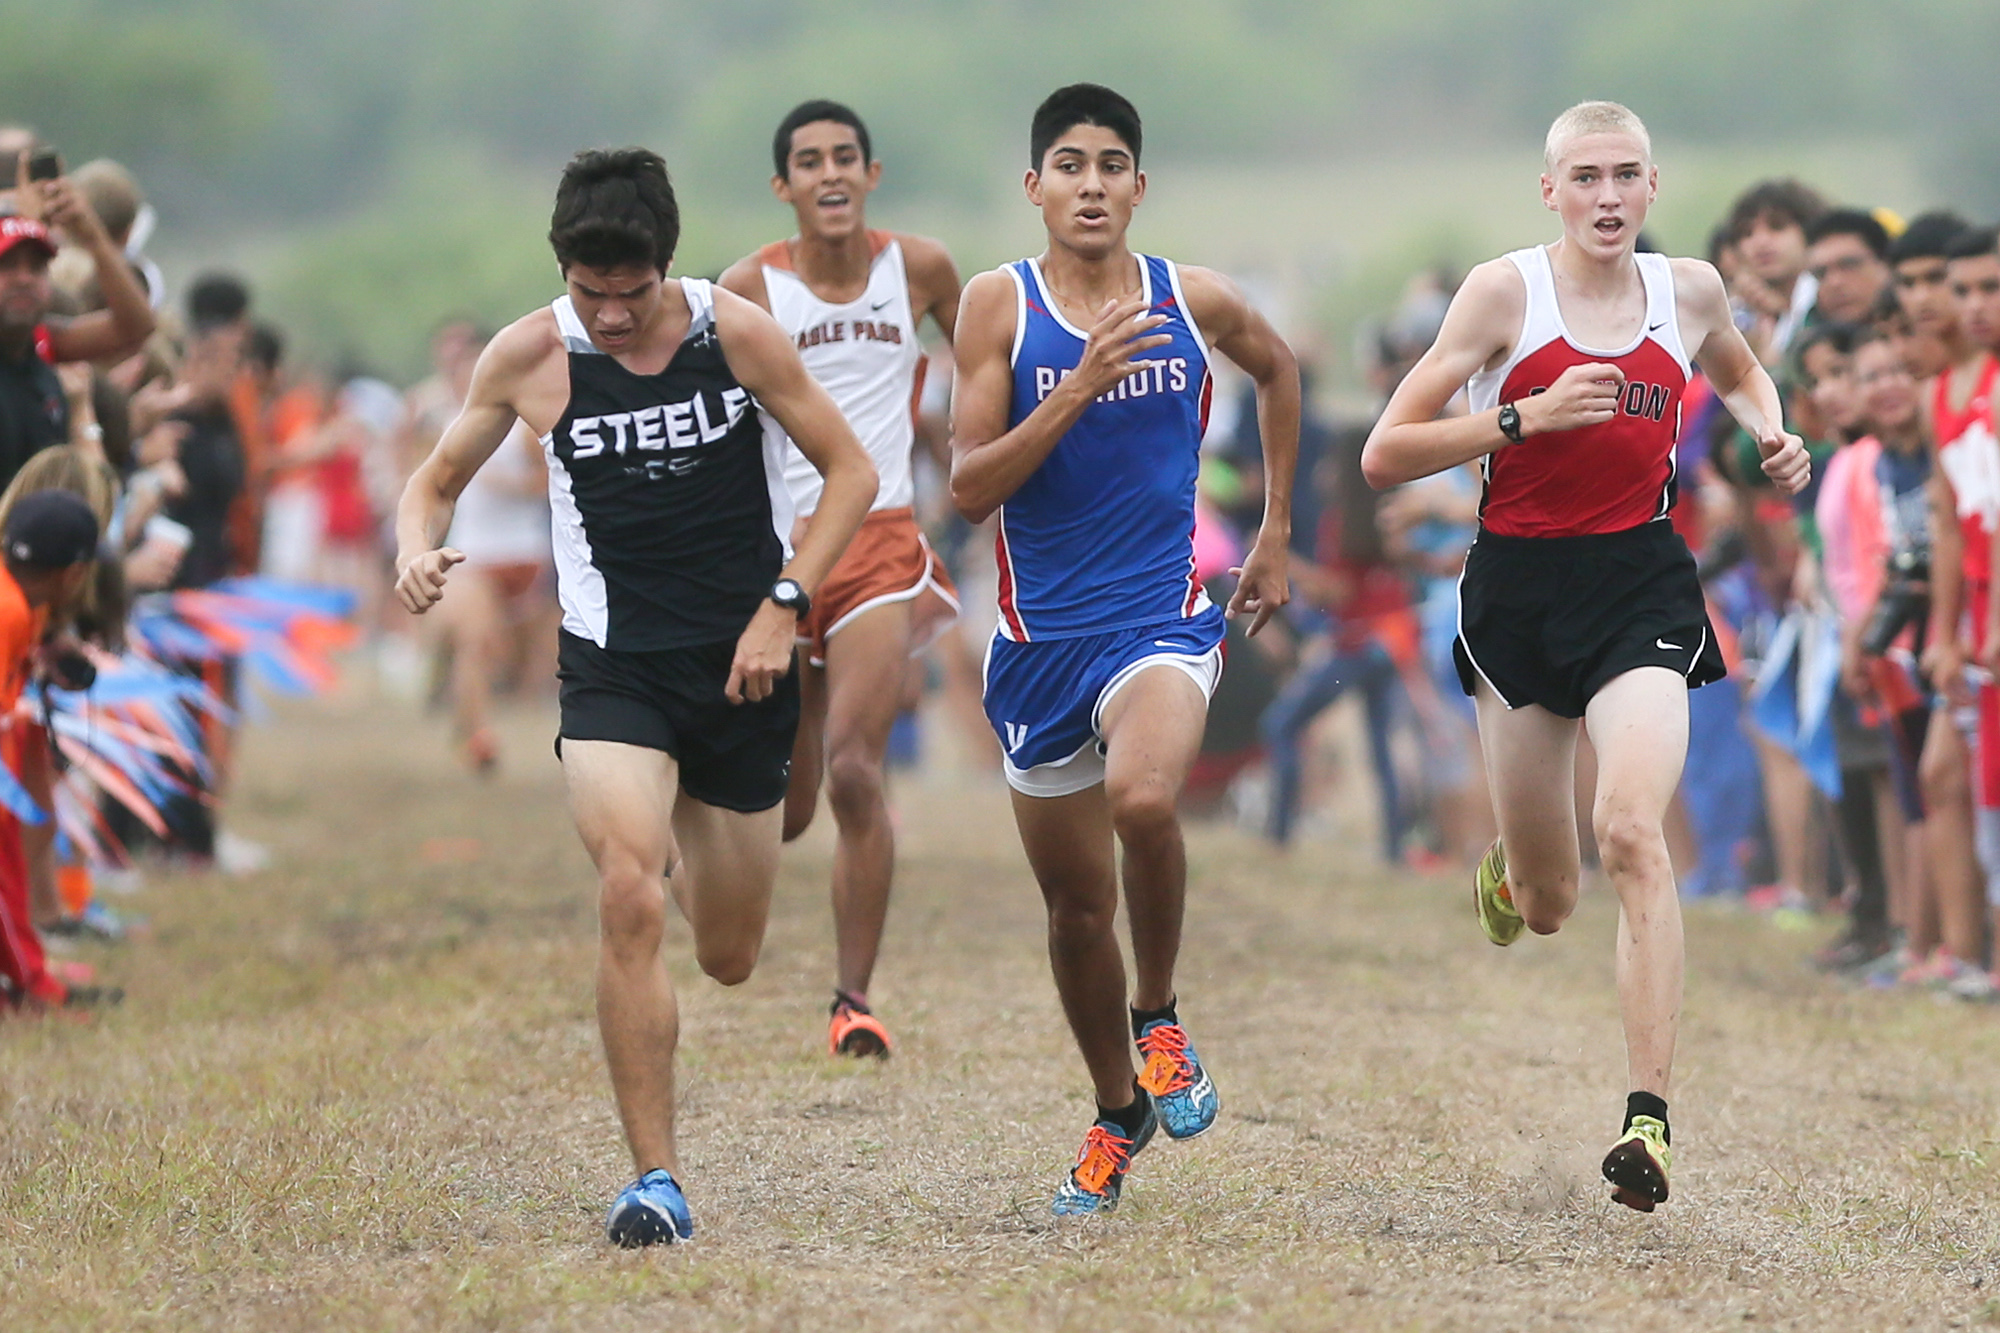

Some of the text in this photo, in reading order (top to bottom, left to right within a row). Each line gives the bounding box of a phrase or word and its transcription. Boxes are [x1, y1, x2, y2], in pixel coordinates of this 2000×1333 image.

[791, 321, 845, 350] AGLE
[1034, 357, 1188, 404] PIOTS
[569, 386, 750, 460] STEELE
